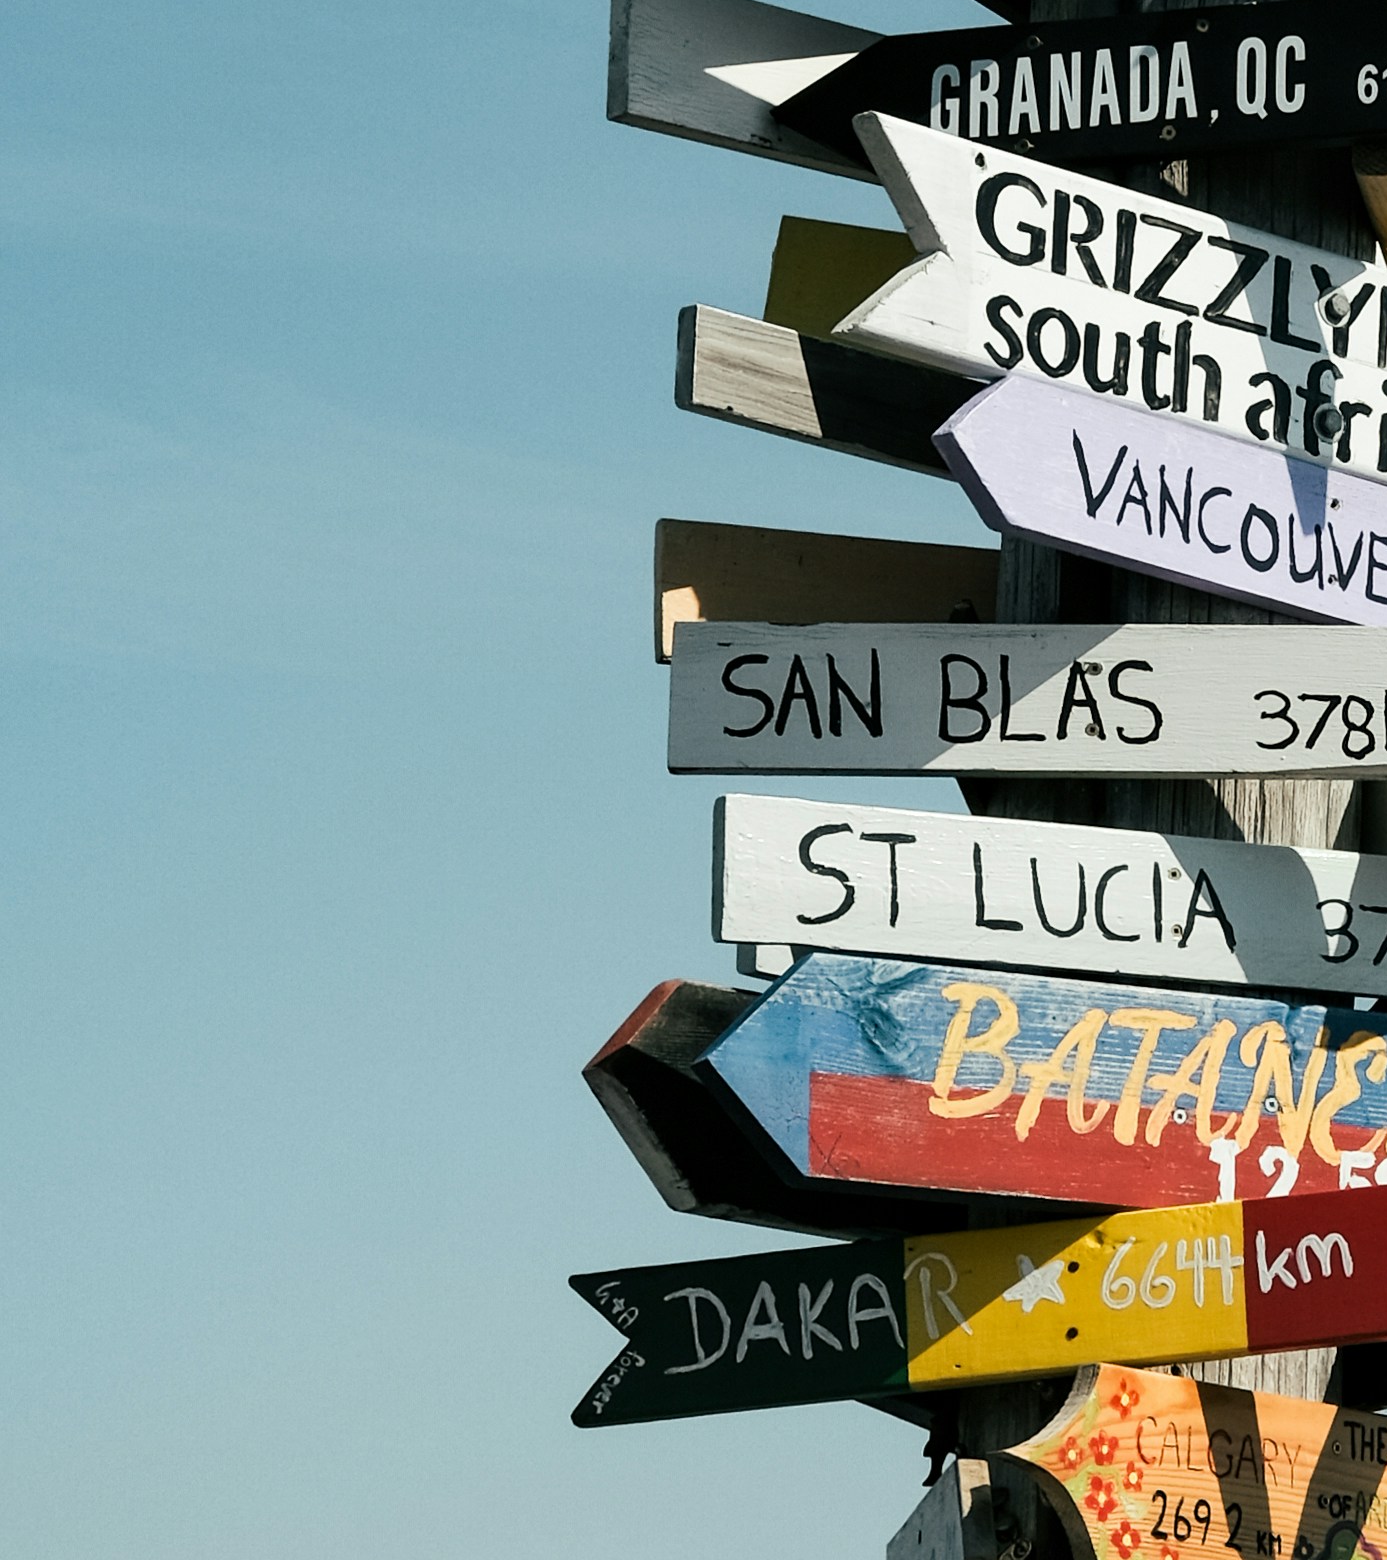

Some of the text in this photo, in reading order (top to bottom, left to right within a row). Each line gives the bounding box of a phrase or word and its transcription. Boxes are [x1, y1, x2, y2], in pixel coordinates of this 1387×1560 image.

[1236, 35, 1307, 119] QC
[985, 293, 1222, 422] south
[720, 648, 884, 740] SAN
[938, 654, 1165, 746] BLAS
[796, 823, 938, 928] ST
[973, 867, 1236, 952] LUCIA
[663, 1230, 1354, 1375] DAKAR 6644 km
[1136, 1415, 1301, 1489] CALGARY
[1255, 1529, 1283, 1557] KM
